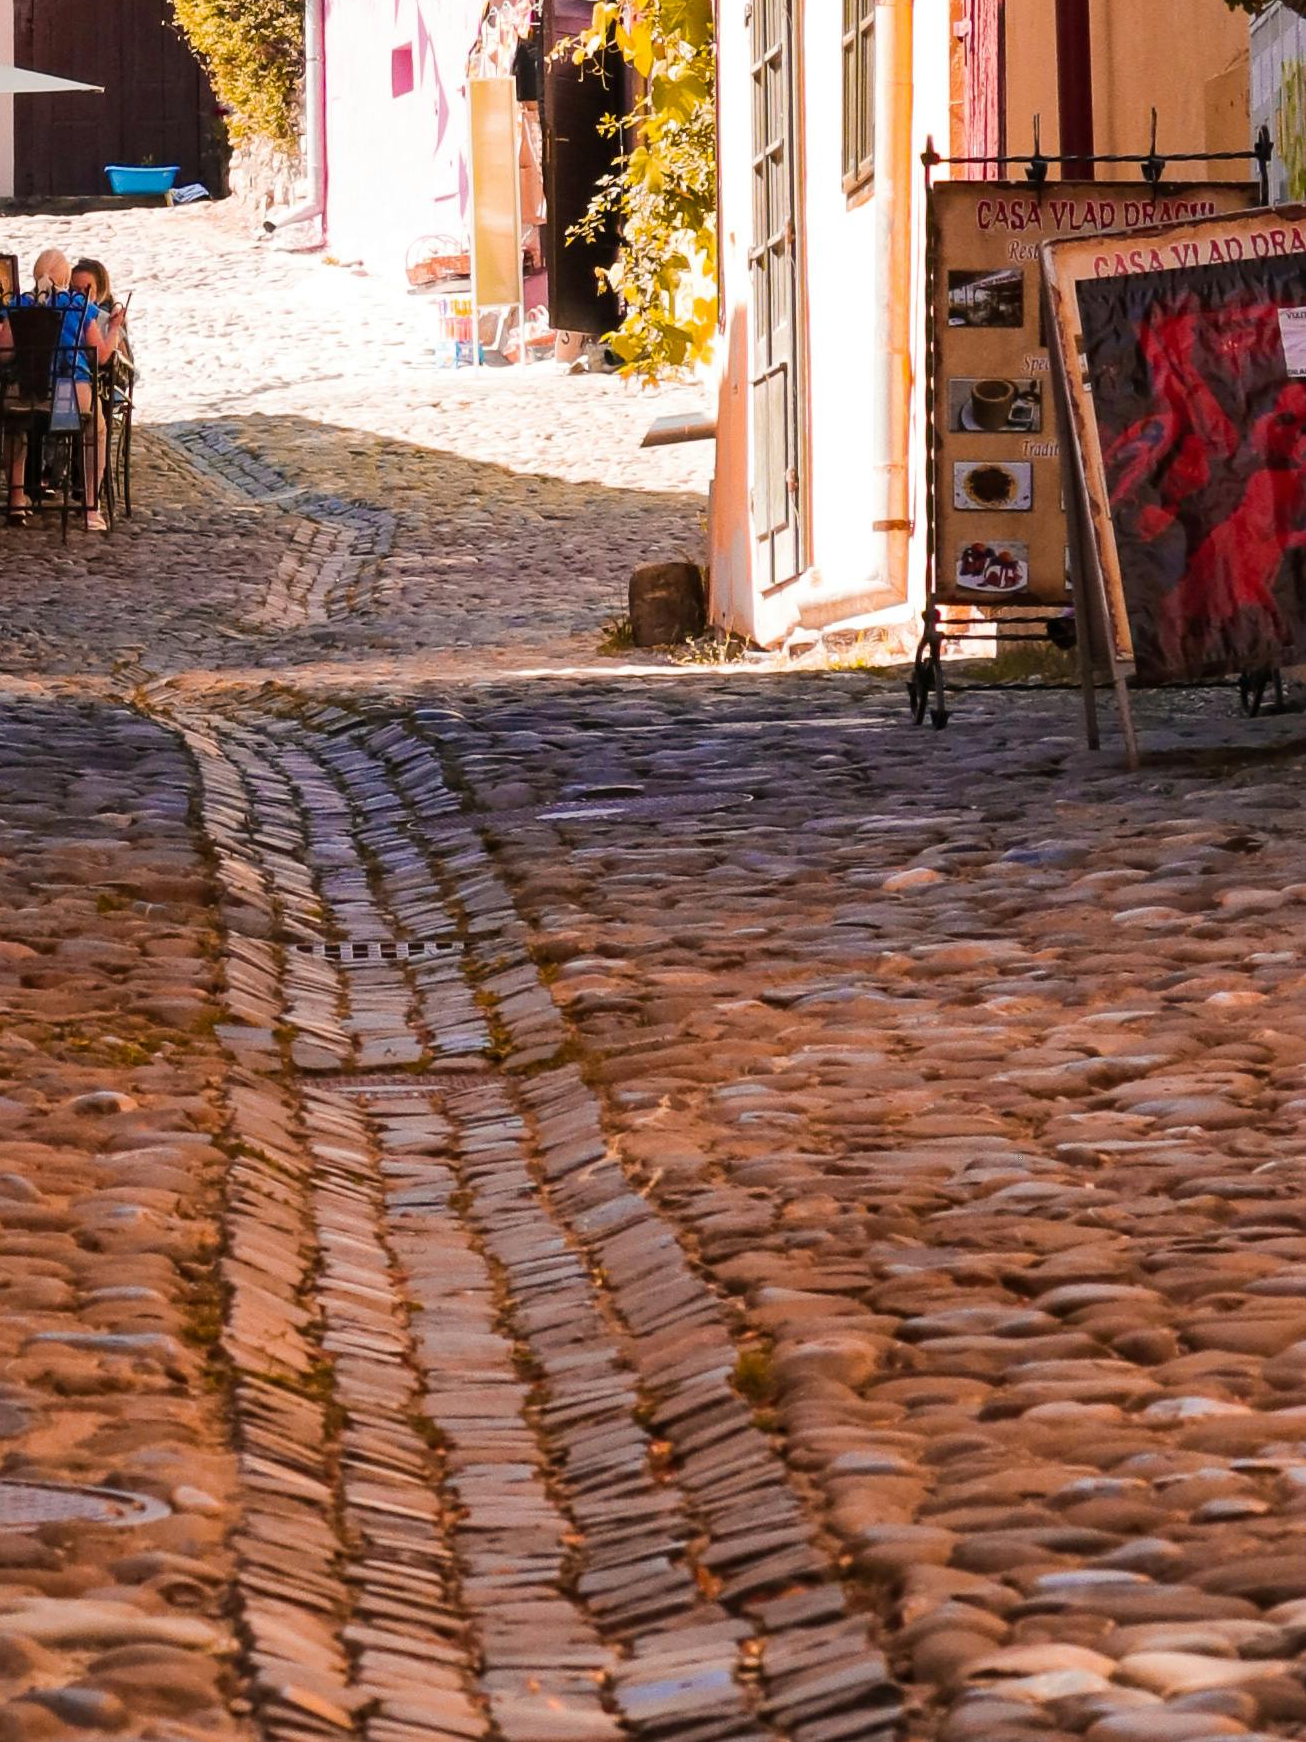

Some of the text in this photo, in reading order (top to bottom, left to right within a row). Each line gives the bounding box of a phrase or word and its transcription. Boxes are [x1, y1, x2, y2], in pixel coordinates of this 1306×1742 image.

[977, 199, 1042, 231] CASA
[1049, 200, 1116, 231] VLAD
[1094, 247, 1165, 278] CASA
